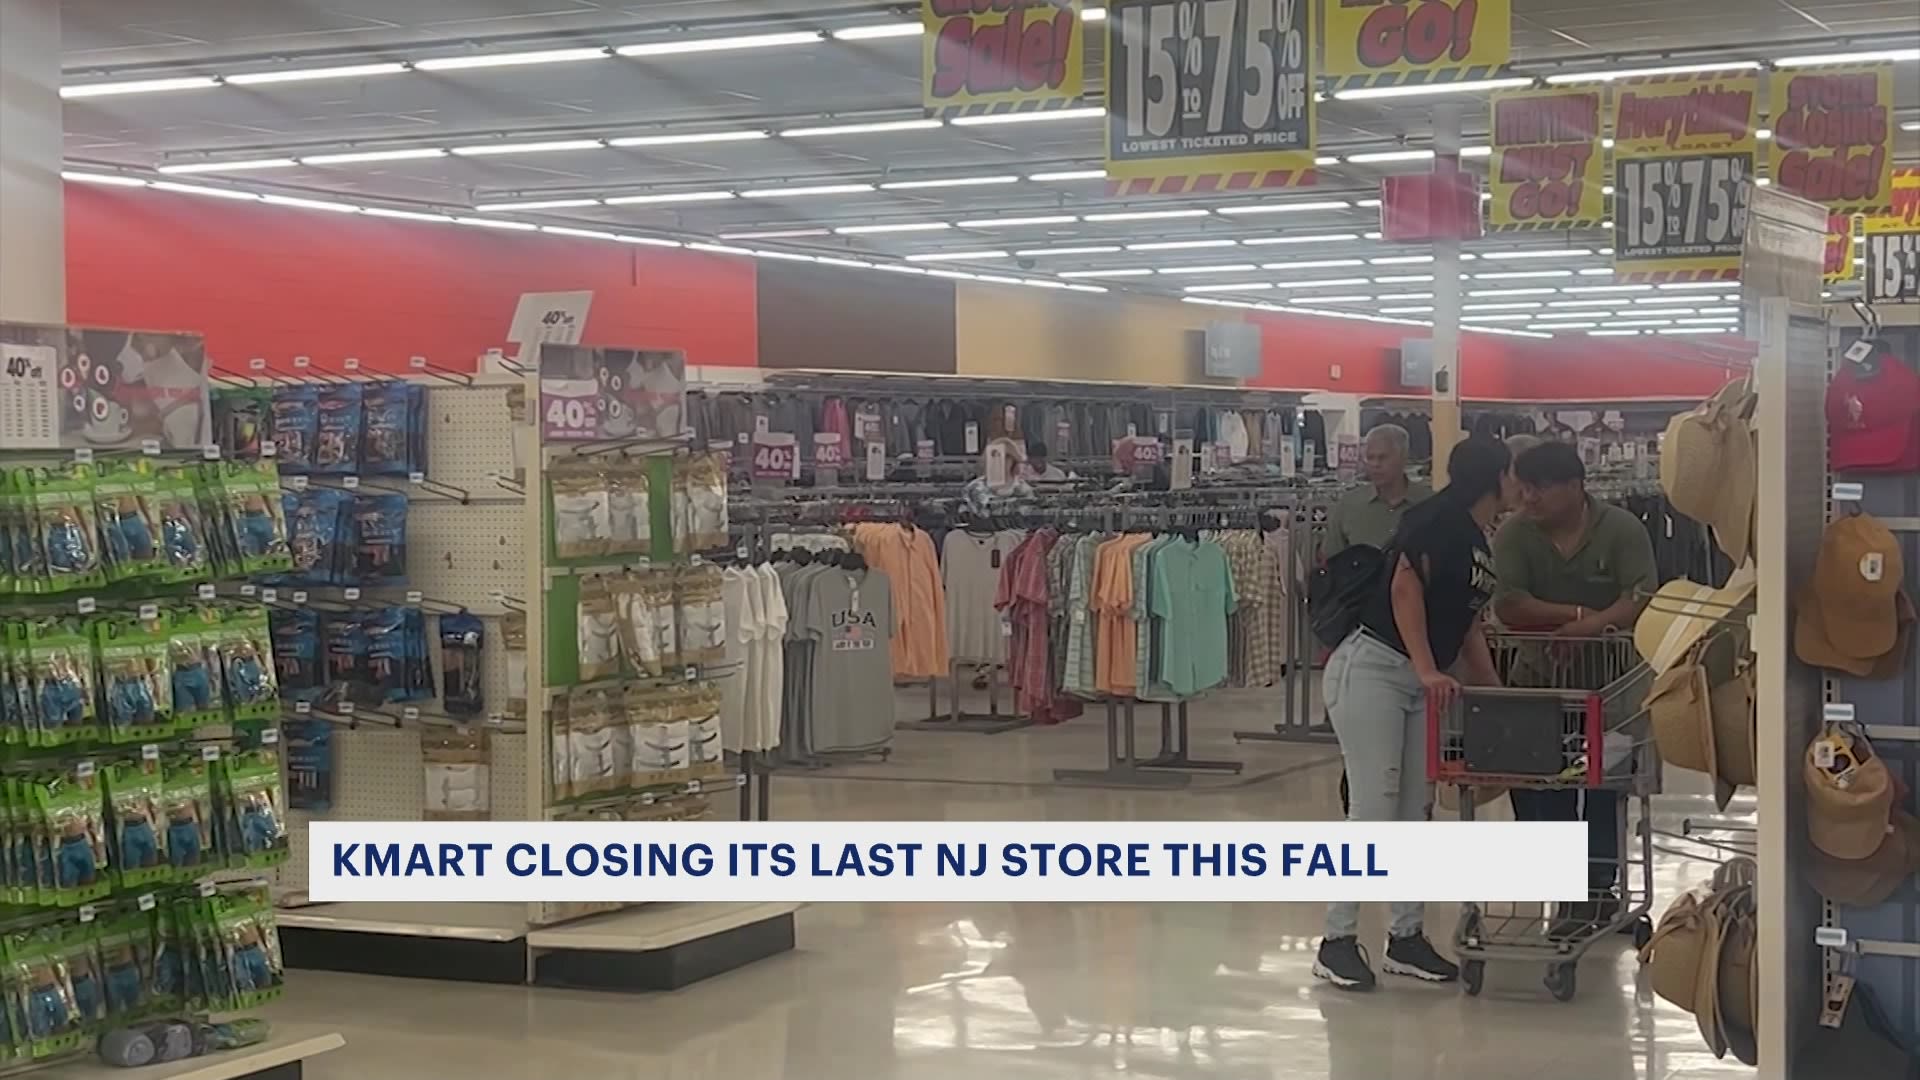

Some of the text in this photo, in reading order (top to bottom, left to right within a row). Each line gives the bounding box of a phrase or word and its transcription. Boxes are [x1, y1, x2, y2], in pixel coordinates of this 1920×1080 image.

[931, 7, 1074, 98] Sale!
[1357, 0, 1478, 68] GO!
[1278, 73, 1305, 120] OFF
[1122, 130, 1298, 153] LOWEST TICKETED PRICE
[1775, 103, 1887, 151] CLOSING
[1777, 143, 1885, 202] Sale!
[1509, 180, 1584, 220] GO!
[831, 609, 877, 628] USA
